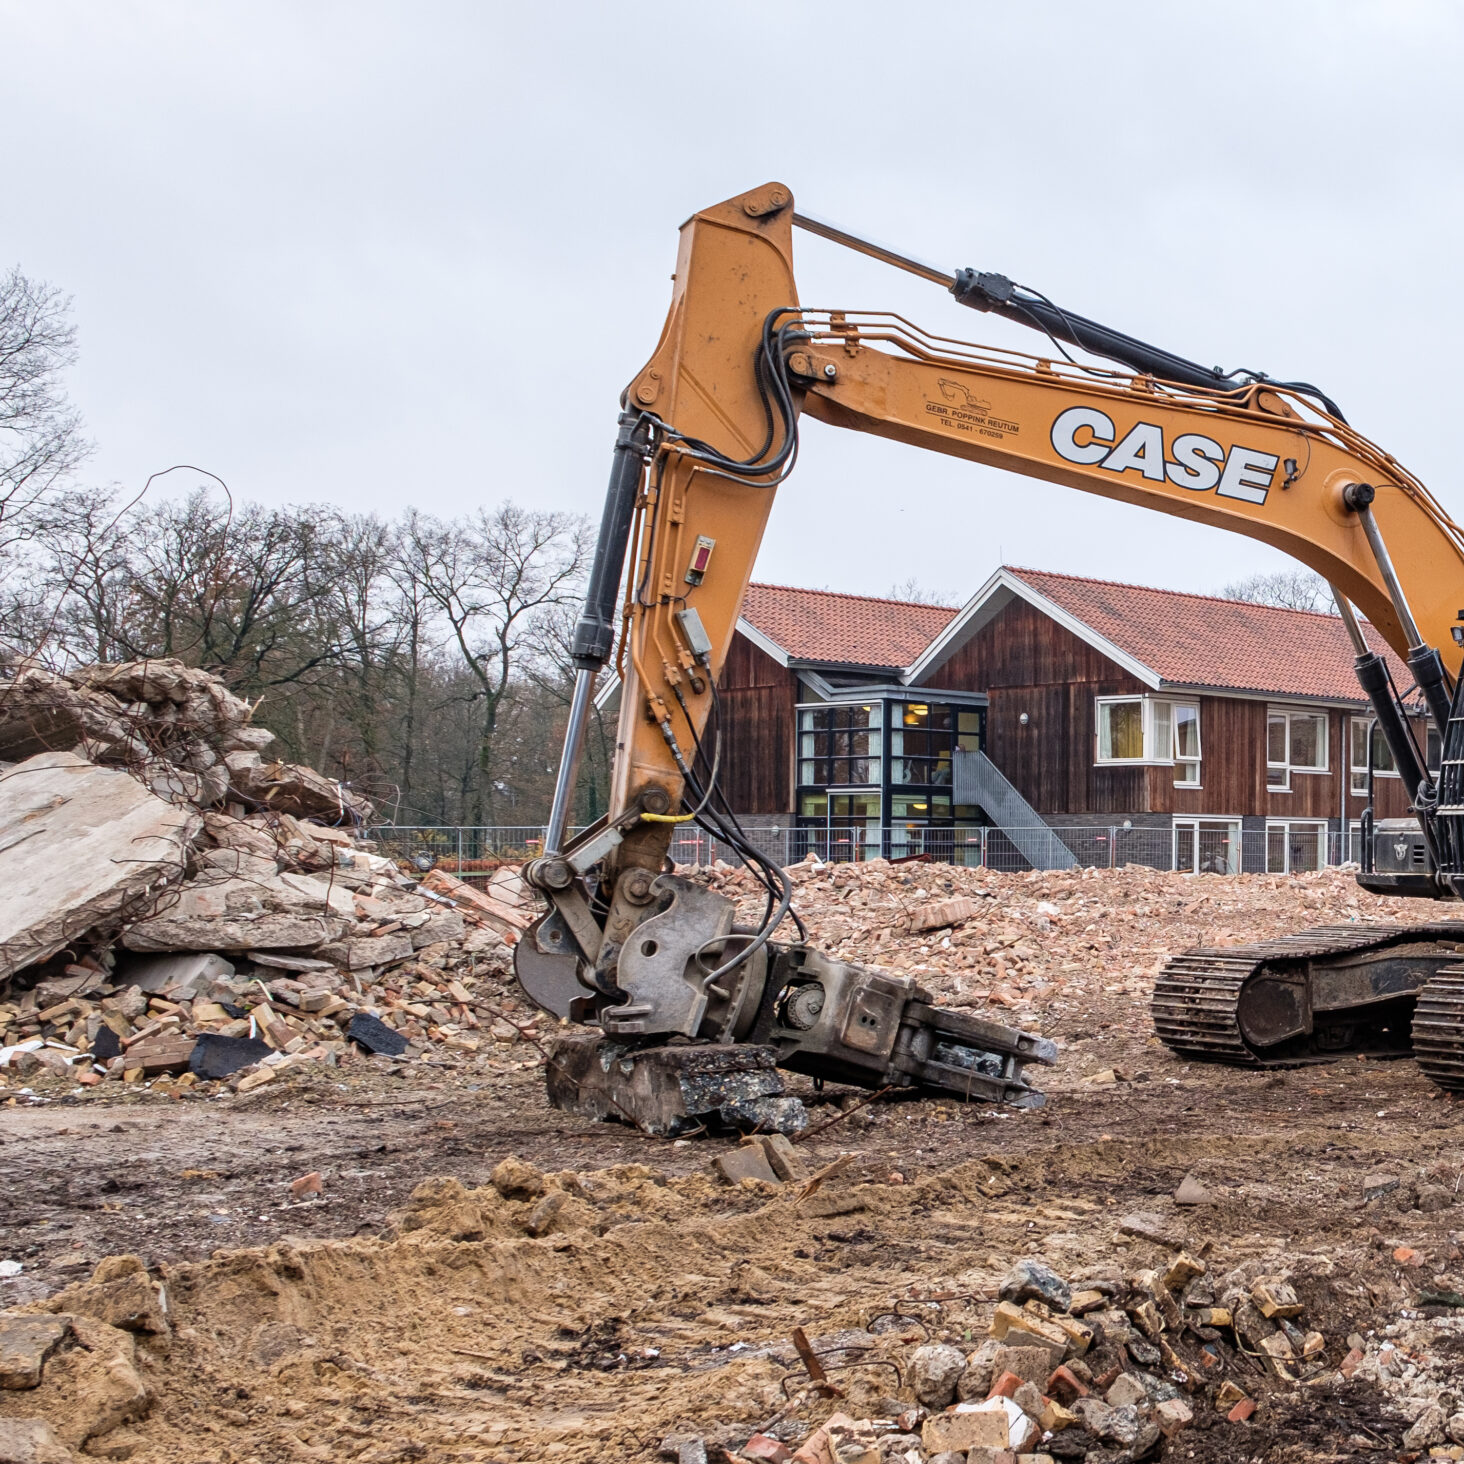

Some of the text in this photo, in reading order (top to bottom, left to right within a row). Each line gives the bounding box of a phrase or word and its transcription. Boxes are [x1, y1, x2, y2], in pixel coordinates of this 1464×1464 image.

[926, 404, 1019, 433] GEBR. POPPINK REUTUM
[957, 422, 973, 432] 0541
[1050, 405, 1280, 506] CASE
